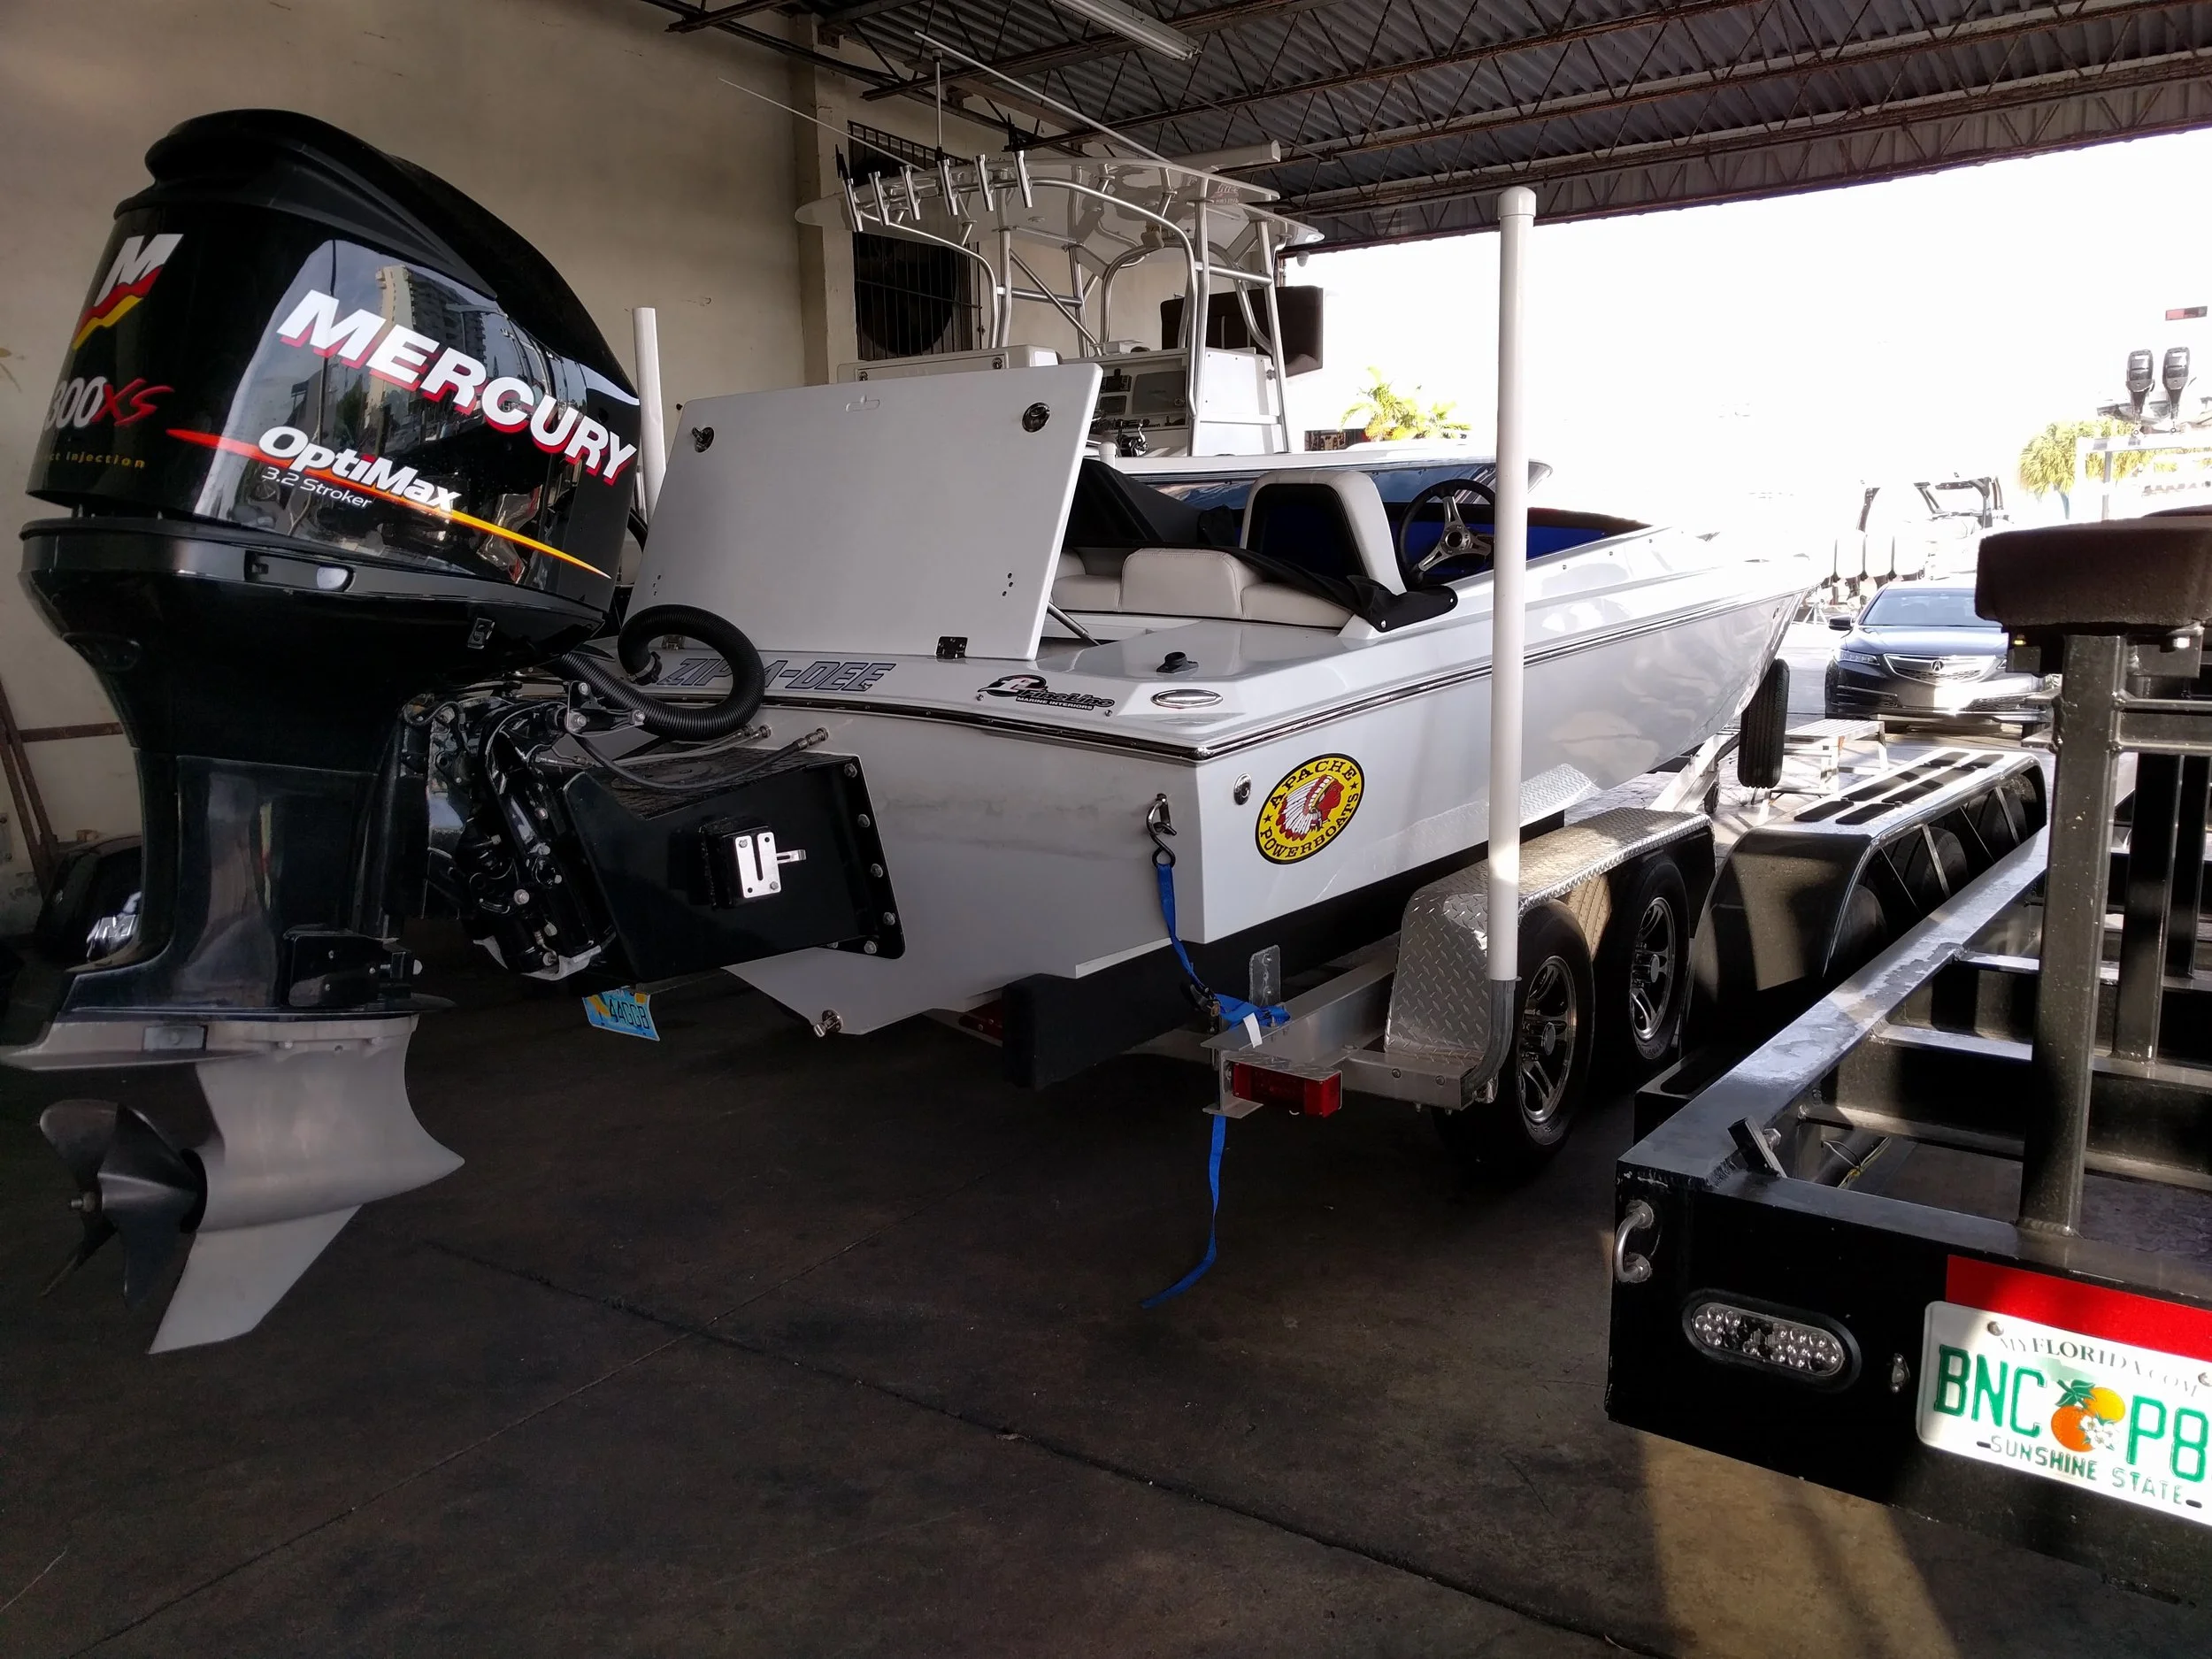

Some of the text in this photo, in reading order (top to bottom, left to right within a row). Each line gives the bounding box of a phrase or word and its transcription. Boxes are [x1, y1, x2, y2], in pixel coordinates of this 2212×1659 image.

[276, 289, 637, 484] MERCURY
[258, 426, 462, 511] OptiMax
[262, 466, 373, 509] 3.2 Stroker
[1017, 696, 1048, 705] MARINE
[1269, 760, 1357, 809] APACHE
[1260, 793, 1359, 857] POWERBOATS
[1933, 1343, 2046, 1439] BNC
[1990, 1434, 2183, 1505] SUNSHINE STATE
